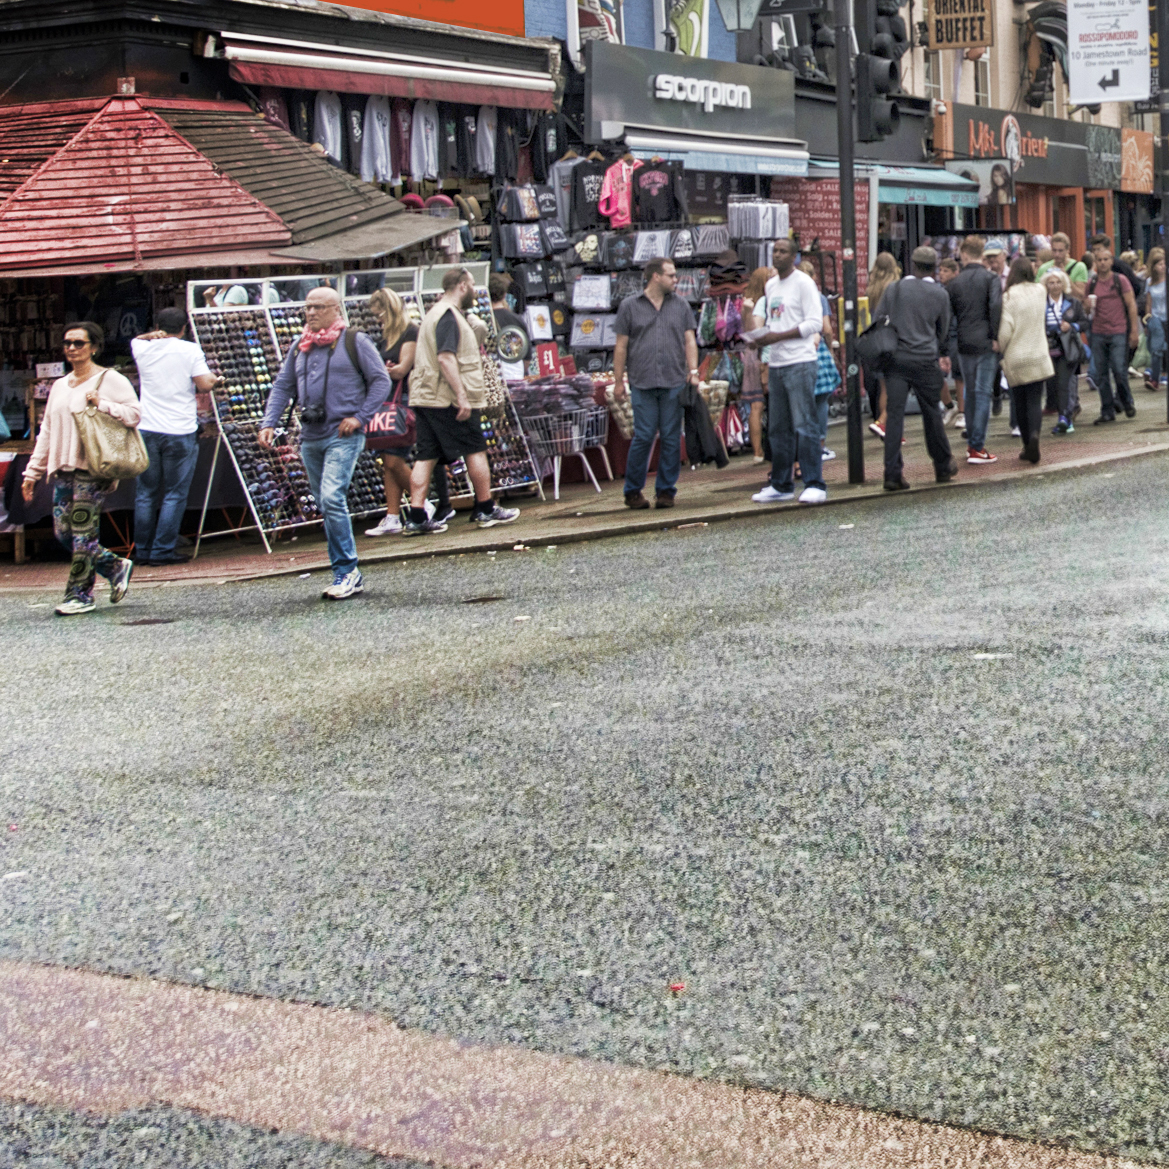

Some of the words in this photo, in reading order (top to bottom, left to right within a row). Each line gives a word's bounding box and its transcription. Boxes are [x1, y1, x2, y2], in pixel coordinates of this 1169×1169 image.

[935, 16, 985, 44] BUFFET
[1071, 52, 1081, 60] 10
[1127, 47, 1147, 56] Road
[655, 74, 752, 112] scorpion
[822, 183, 840, 191] SALE
[809, 211, 833, 219] Soldes
[824, 229, 842, 237] SALE
[543, 350, 555, 370] £1
